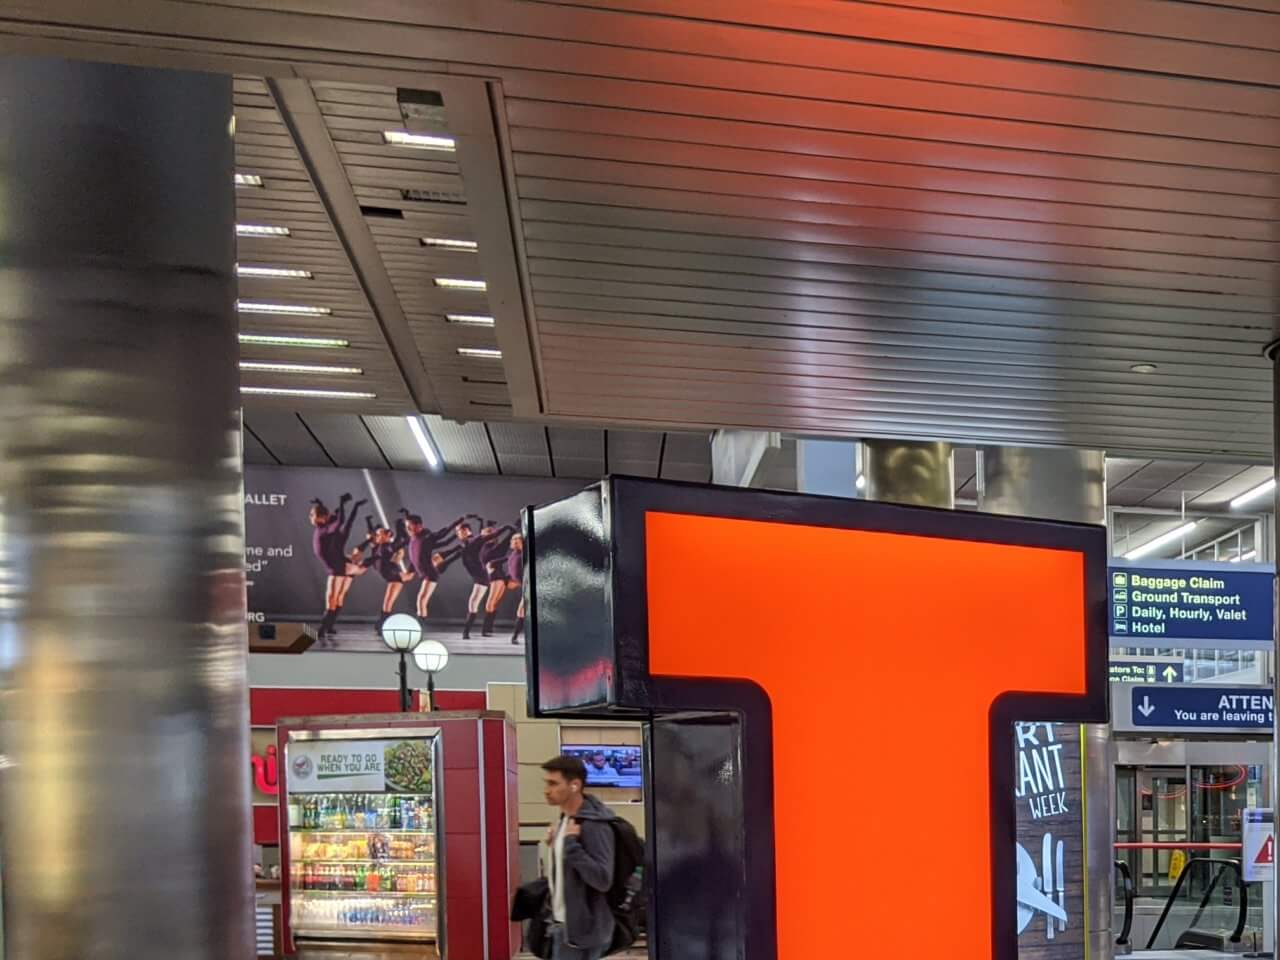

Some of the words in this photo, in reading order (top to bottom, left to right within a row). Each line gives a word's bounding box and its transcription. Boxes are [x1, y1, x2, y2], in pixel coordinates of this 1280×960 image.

[267, 544, 293, 557] and
[1131, 575, 1186, 590] Baggage
[1189, 577, 1225, 589] Claim
[1132, 591, 1178, 603] Ground
[1181, 592, 1241, 606] Transport
[1132, 606, 1166, 619] Daily,
[1169, 607, 1213, 621] Hourly,
[1216, 609, 1247, 621] Valet
[1132, 622, 1165, 633] Hotel
[1218, 695, 1273, 710] ATTEN
[1174, 710, 1197, 721] You
[1200, 712, 1219, 721] are
[1223, 711, 1265, 723] leaving
[320, 754, 350, 764] READY
[351, 753, 362, 763] TO
[317, 763, 342, 773] WHEN
[344, 763, 362, 772] YOU
[364, 762, 381, 772] ARE
[1029, 792, 1069, 819] WEEK
